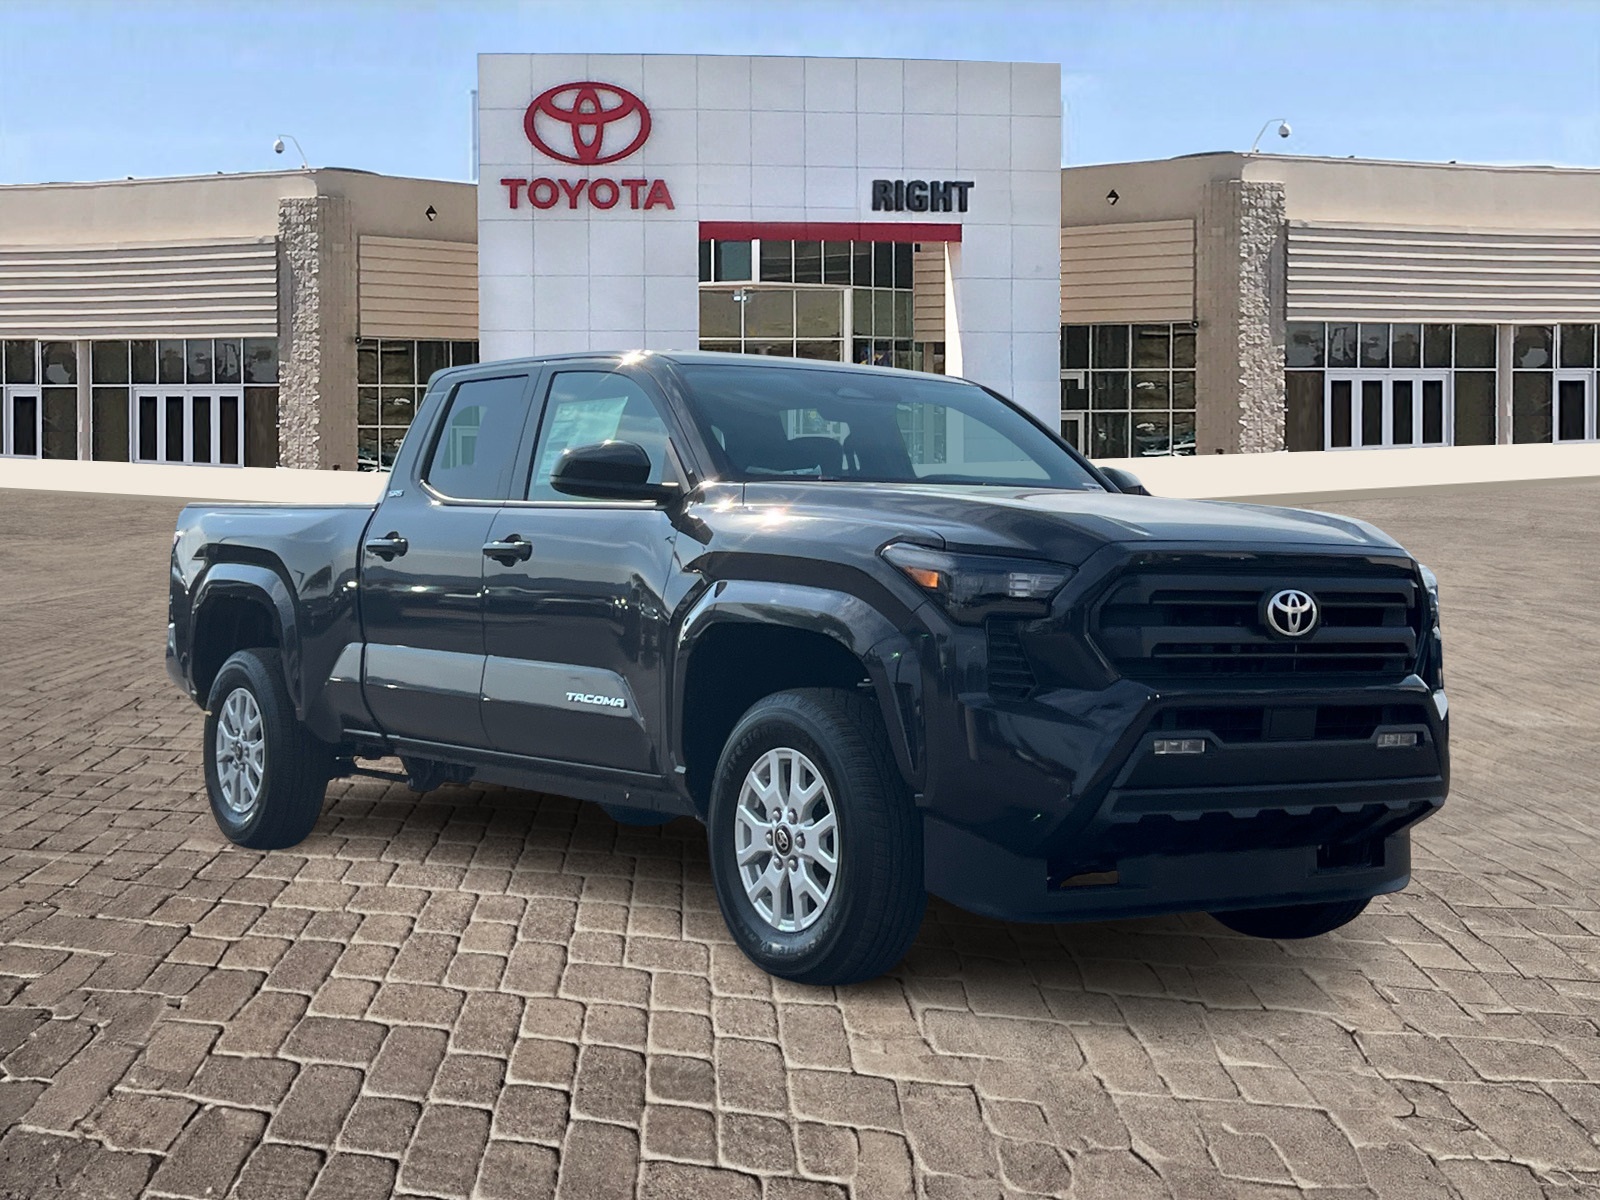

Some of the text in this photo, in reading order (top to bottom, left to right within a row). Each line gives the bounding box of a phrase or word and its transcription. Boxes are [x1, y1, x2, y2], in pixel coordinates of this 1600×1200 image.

[501, 178, 675, 210] TOYOTA
[872, 179, 975, 212] RIGHT
[566, 691, 626, 708] TACOMA
